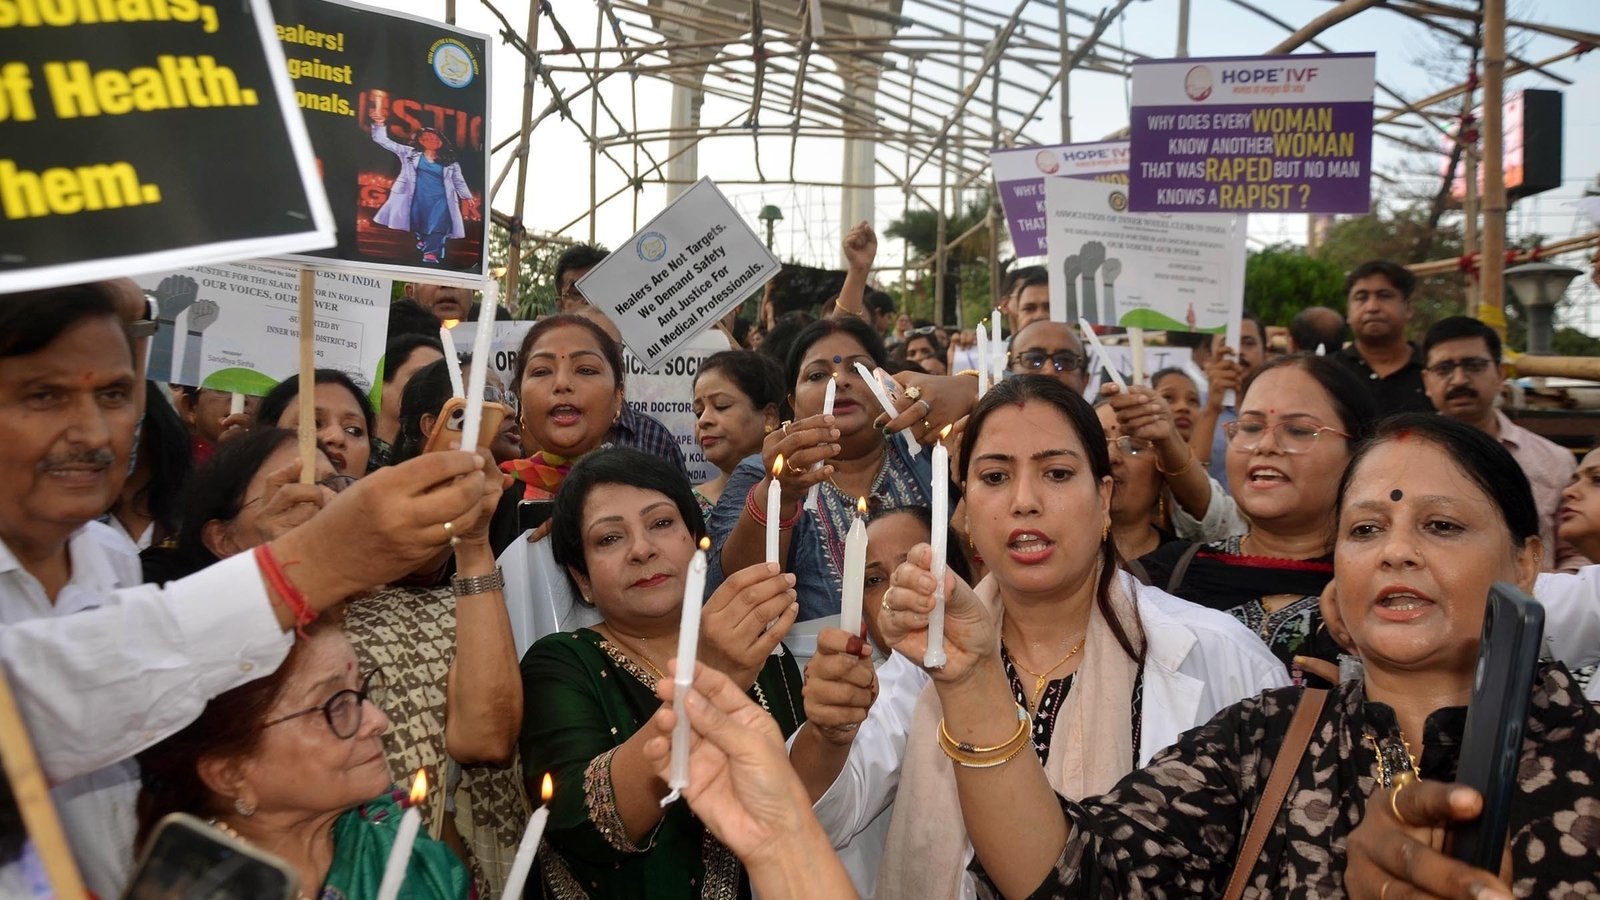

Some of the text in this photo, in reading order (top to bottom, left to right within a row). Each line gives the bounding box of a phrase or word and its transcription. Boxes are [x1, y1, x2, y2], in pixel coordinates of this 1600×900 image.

[0, 0, 219, 33] sionals,
[273, 24, 344, 52] ealers!
[288, 58, 352, 85] gainst
[1222, 67, 1319, 83] HOPE IVF
[43, 55, 259, 119] Health.
[295, 91, 356, 116] onals.
[1147, 107, 1333, 133] WHY DOES EVERY WOMAN
[1063, 148, 1129, 162] HOPE IV
[1168, 132, 1354, 157] KNOW ANOTHER WOMAN
[1140, 161, 1174, 178] THAT
[1176, 161, 1205, 178] WAS
[1205, 156, 1273, 182] RAPED
[1273, 161, 1302, 178] BUT
[1304, 161, 1325, 178] NO
[1327, 161, 1360, 178] MAN
[0, 159, 161, 219] hem.
[1013, 185, 1037, 198] WHY
[1157, 184, 1312, 209] KNOWS A RAPIST ?
[316, 271, 381, 289] UBS IN INDIA
[614, 281, 653, 316] Healers
[650, 268, 670, 288] Are
[667, 252, 689, 273] Not
[685, 223, 727, 257] Targets.
[637, 302, 657, 319] We
[653, 270, 695, 306] Demand
[692, 244, 727, 276] Safety
[202, 278, 227, 291] OUR
[274, 292, 298, 304] OUR
[313, 300, 338, 312] WER
[232, 270, 249, 282] FOR
[250, 275, 268, 286] THE
[269, 279, 293, 291] SLAIN
[328, 290, 337, 299] IN
[338, 293, 375, 307] KOLKATA
[657, 264, 730, 328] And Justice For
[646, 262, 765, 359] All Medical Professionals.
[266, 325, 289, 336] INNER
[316, 334, 346, 346] DISTRICT
[346, 341, 358, 350] 325
[331, 323, 340, 331] BY
[664, 356, 704, 376] SOCI
[650, 402, 692, 413] DOCTOR
[688, 470, 707, 480] NDIA
